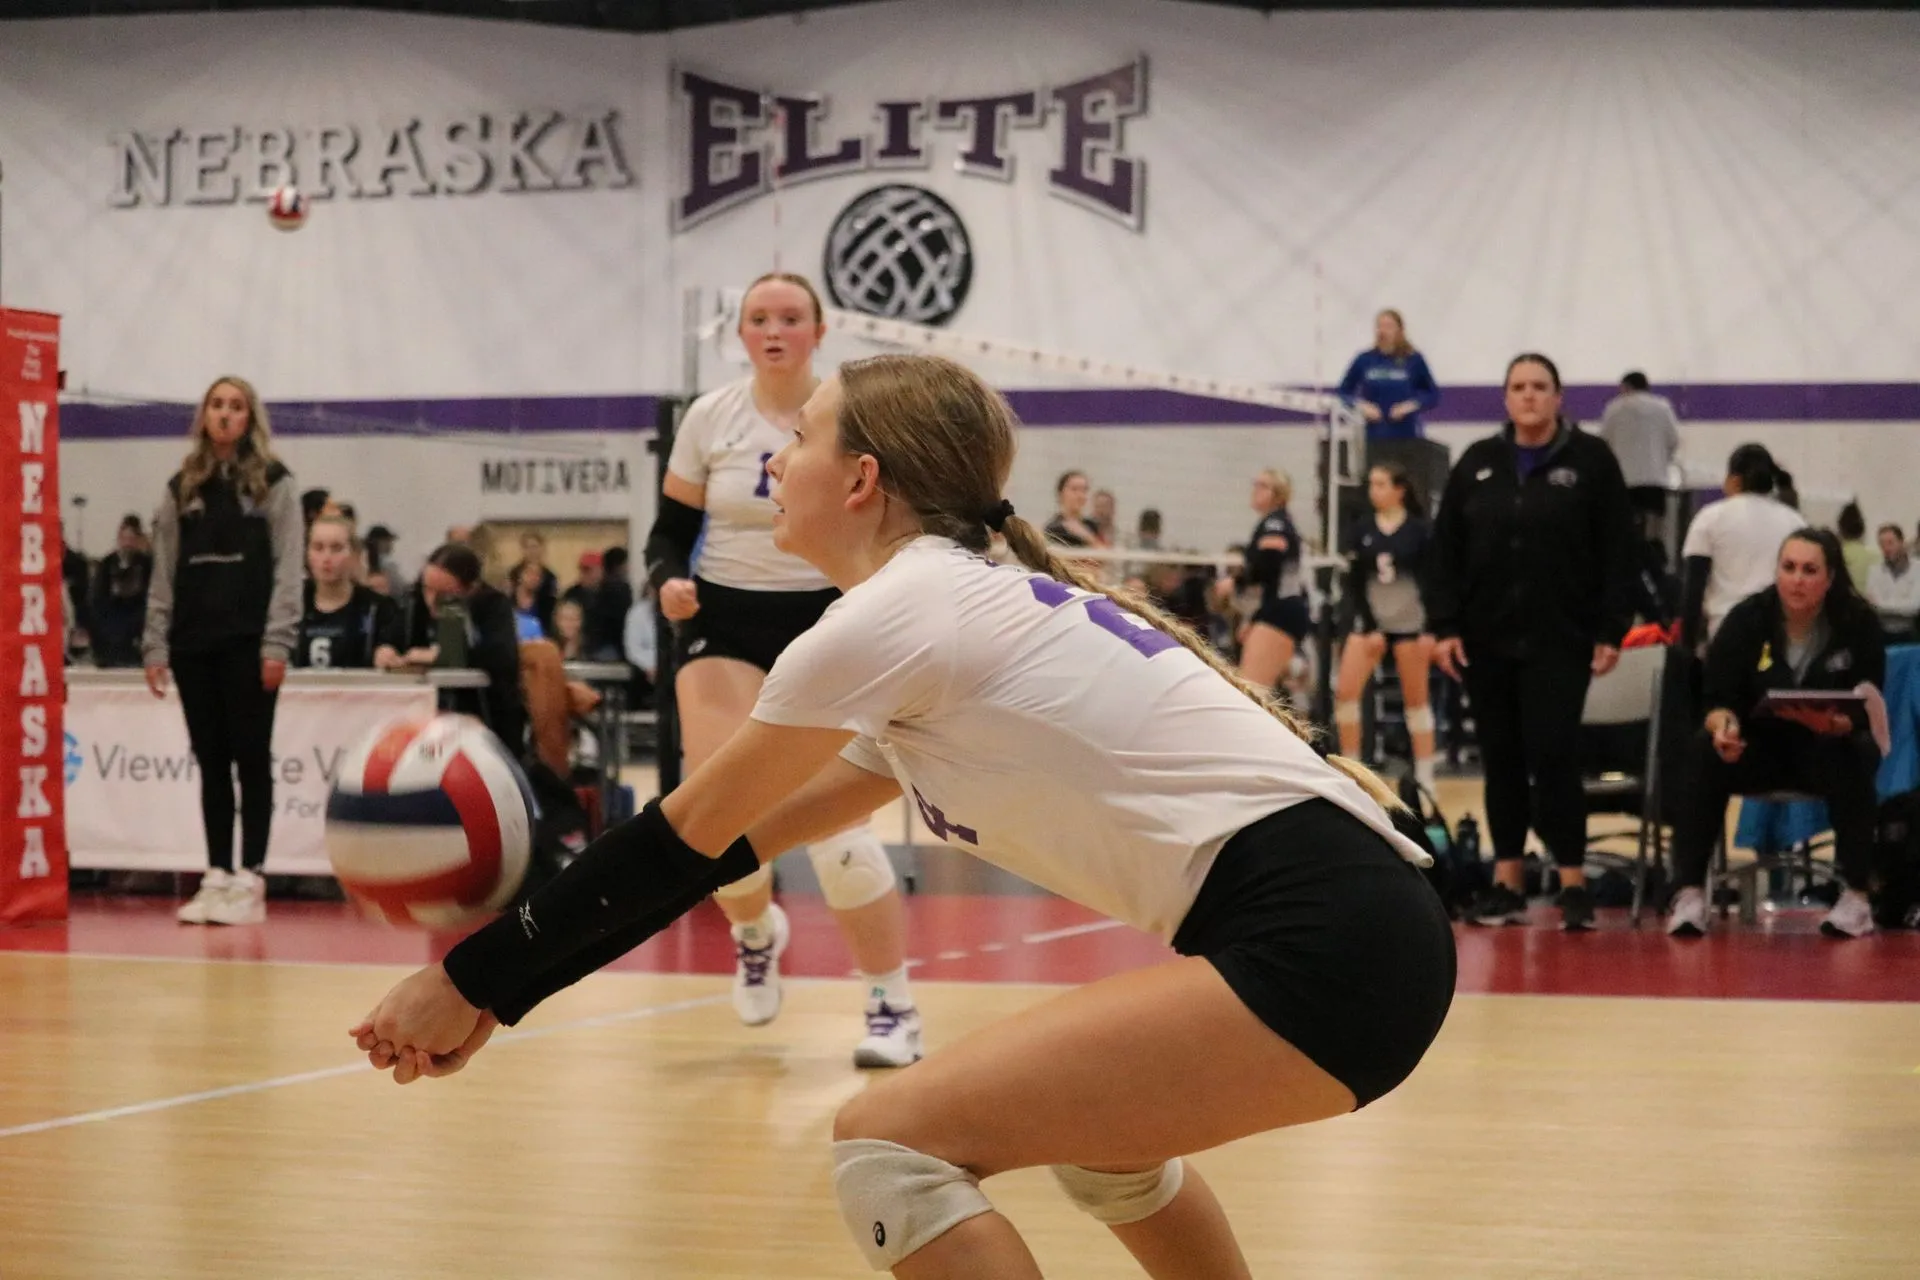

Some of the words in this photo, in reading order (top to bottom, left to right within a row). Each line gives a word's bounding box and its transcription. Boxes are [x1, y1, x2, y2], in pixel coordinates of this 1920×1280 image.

[107, 110, 639, 208] NEBRASKA
[672, 55, 1147, 233] ELITE
[480, 459, 631, 494] MOTIVERA
[17, 400, 52, 879] NEBRASKA
[310, 636, 332, 667] 6
